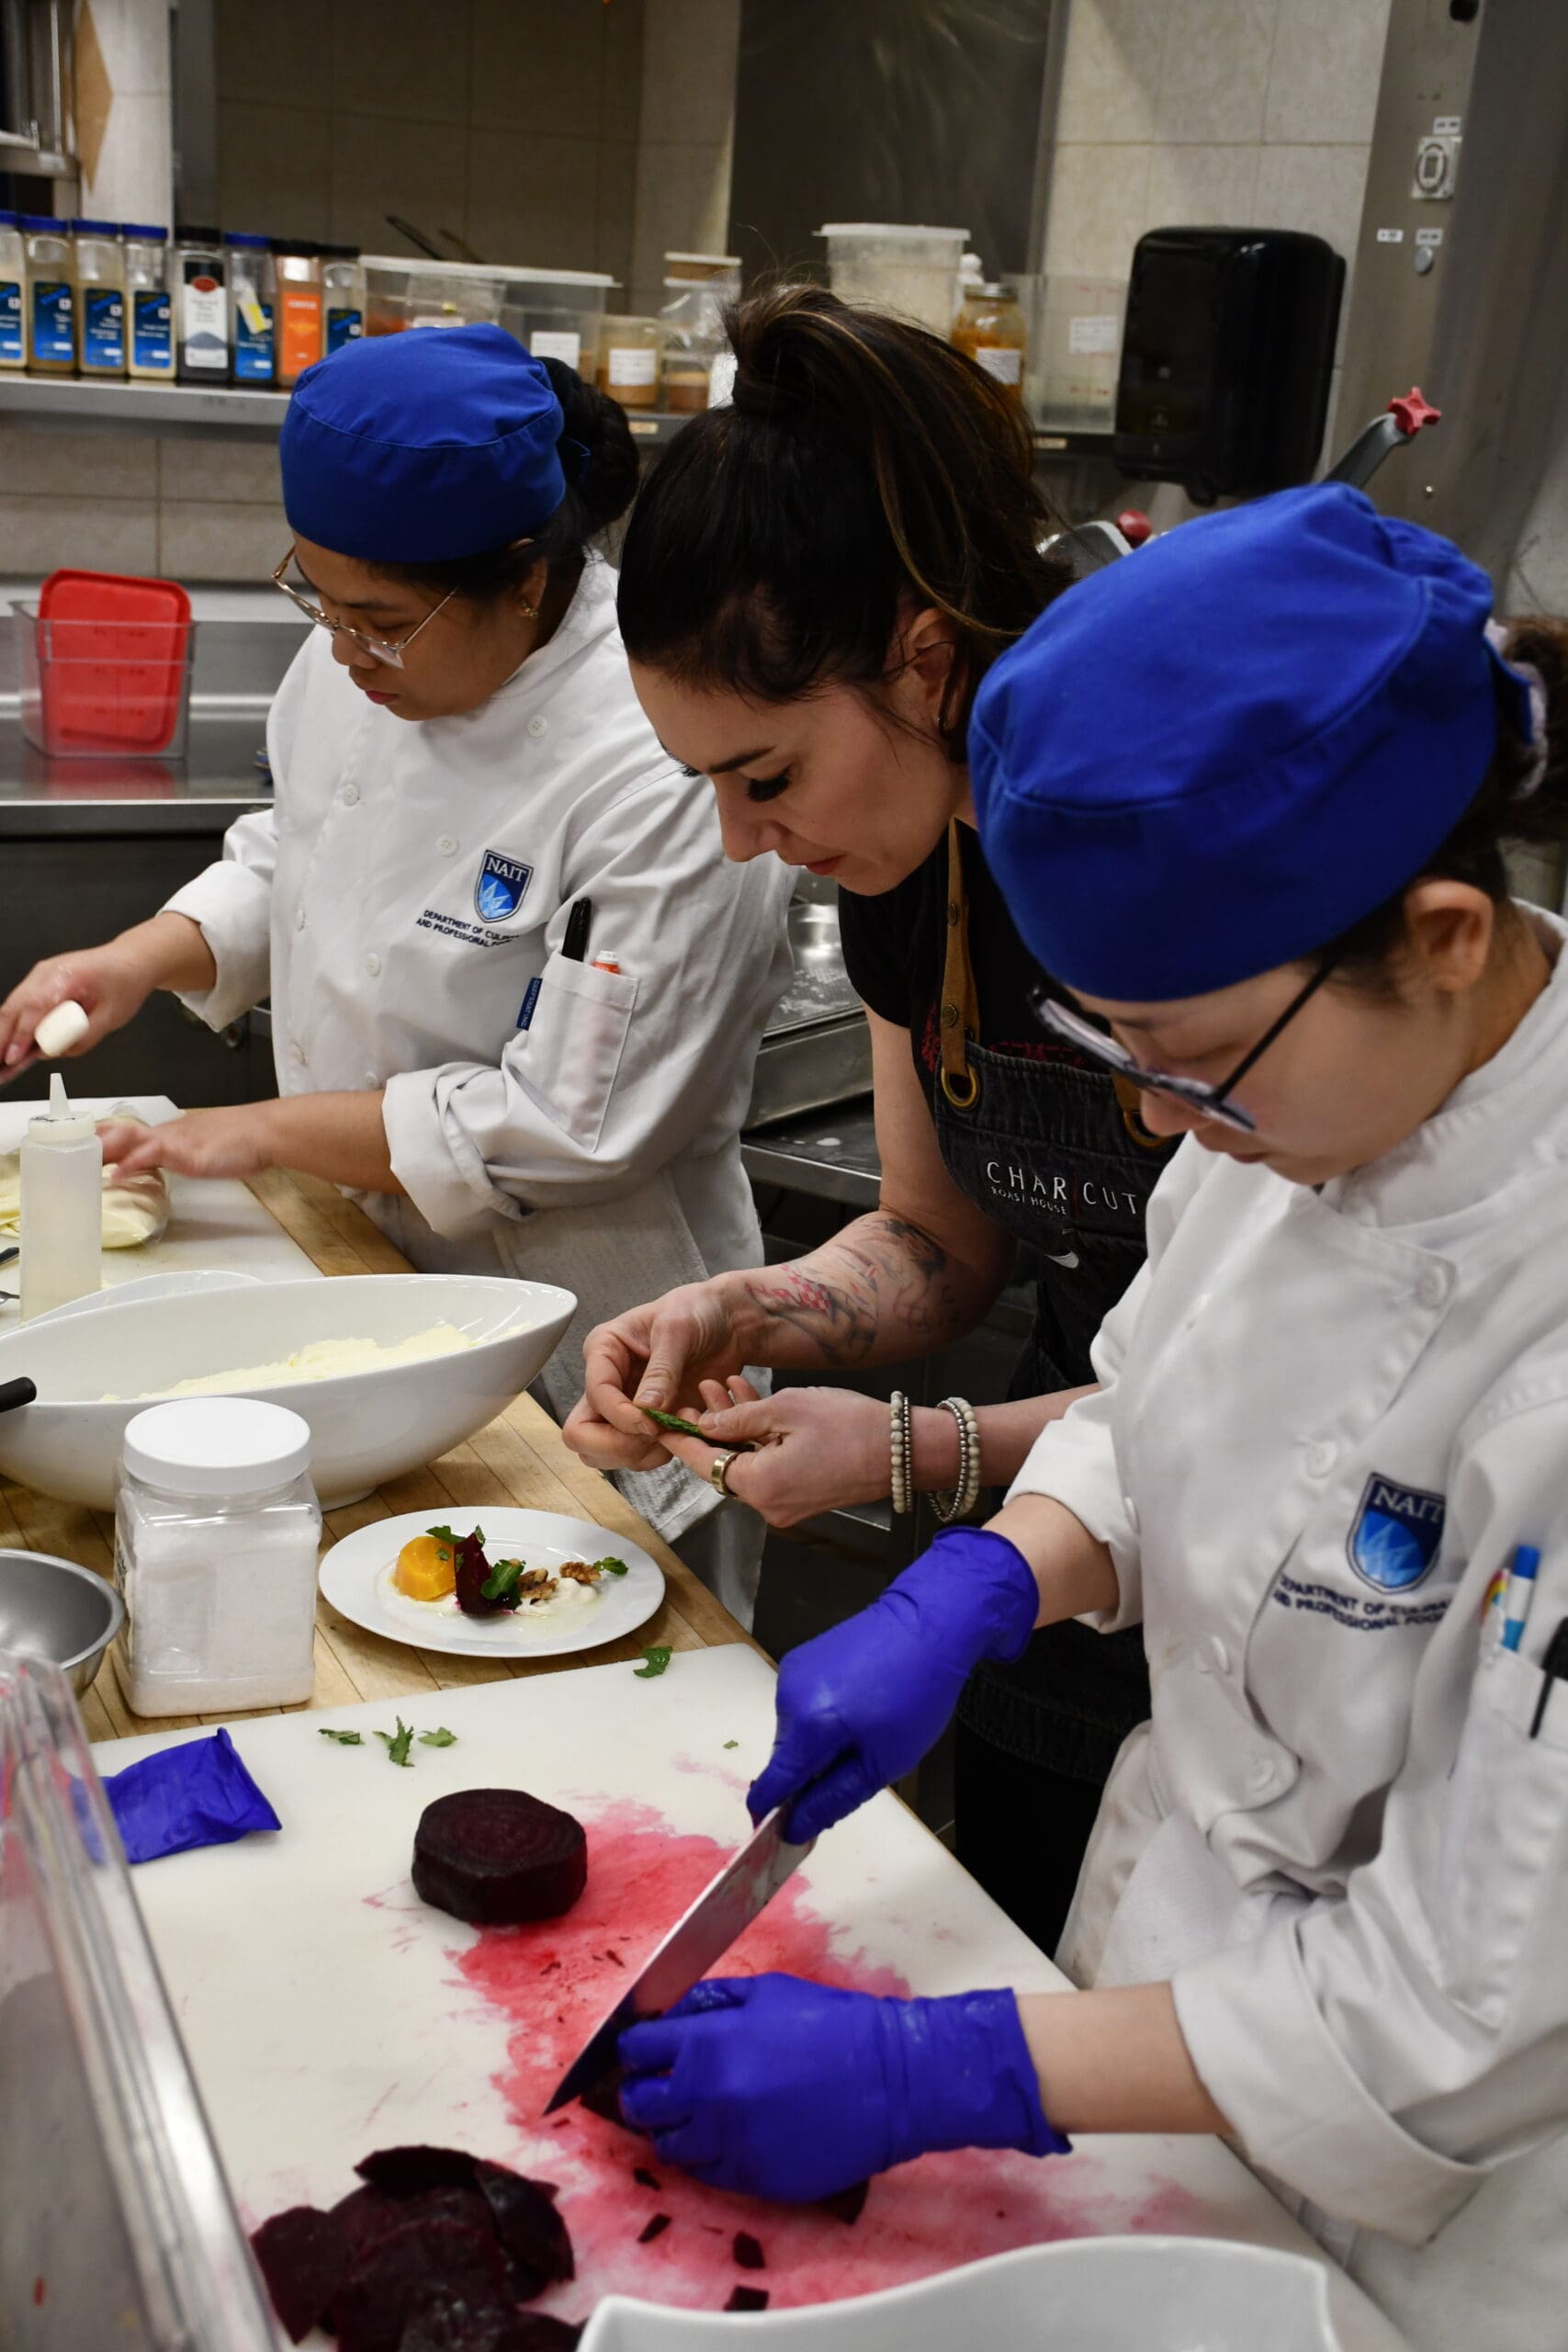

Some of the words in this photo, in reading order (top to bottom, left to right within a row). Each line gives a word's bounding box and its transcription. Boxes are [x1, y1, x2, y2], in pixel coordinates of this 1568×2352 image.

[486, 857, 527, 882] NAIT
[416, 918, 432, 929] AND
[434, 924, 490, 947] PROFESSIONAL
[423, 910, 471, 930] DEPARTMENT
[472, 926, 484, 934] OF
[1030, 1196, 1066, 1215] HOUSE
[1373, 1486, 1445, 1523] NAIT
